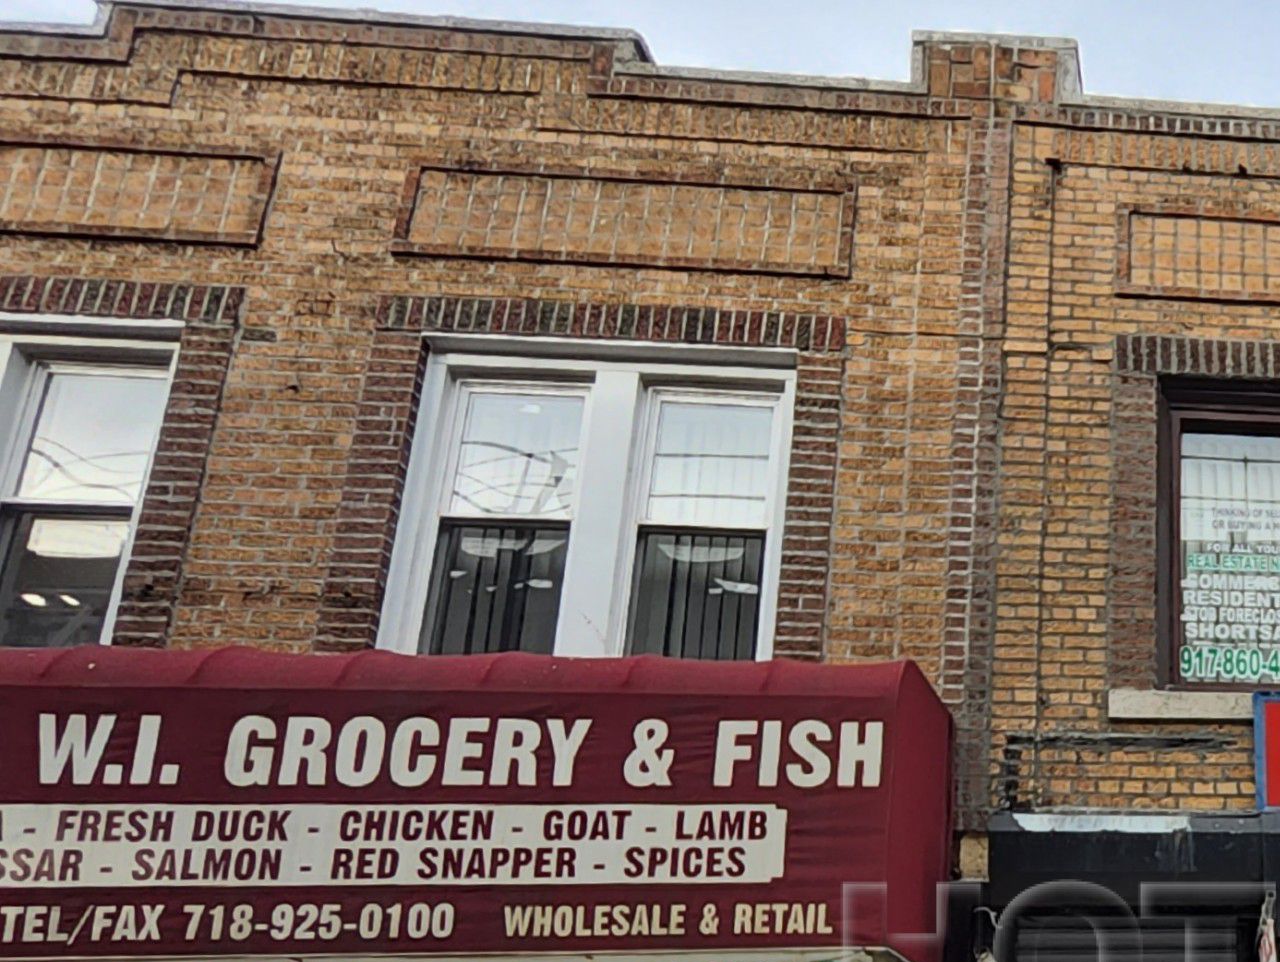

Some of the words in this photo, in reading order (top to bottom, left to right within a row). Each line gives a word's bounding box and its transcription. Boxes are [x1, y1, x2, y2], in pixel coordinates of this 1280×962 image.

[1187, 553, 1217, 571] REAL
[1220, 554, 1268, 572] ESTATE
[1207, 543, 1230, 553] FOR
[1232, 543, 1253, 553] ALL
[38, 713, 180, 785] W.I.
[224, 715, 593, 787] GROCERY
[623, 718, 675, 787] &
[713, 720, 884, 788] FISH
[55, 810, 174, 842] FRESH
[191, 810, 291, 842] DUCK
[339, 810, 494, 841] CHICKEN
[543, 809, 632, 841] GOAT
[675, 810, 767, 840] LAMB
[131, 848, 282, 880] SALMON
[331, 848, 399, 879] RED
[417, 847, 577, 879] SNAPPER
[624, 847, 746, 877] SPICES
[1, 904, 164, 945] TEL/FAX
[183, 903, 455, 941] 718-925-0100
[504, 904, 686, 937] WHOLESALE
[699, 904, 719, 935] &
[733, 902, 833, 934] RETAIL
